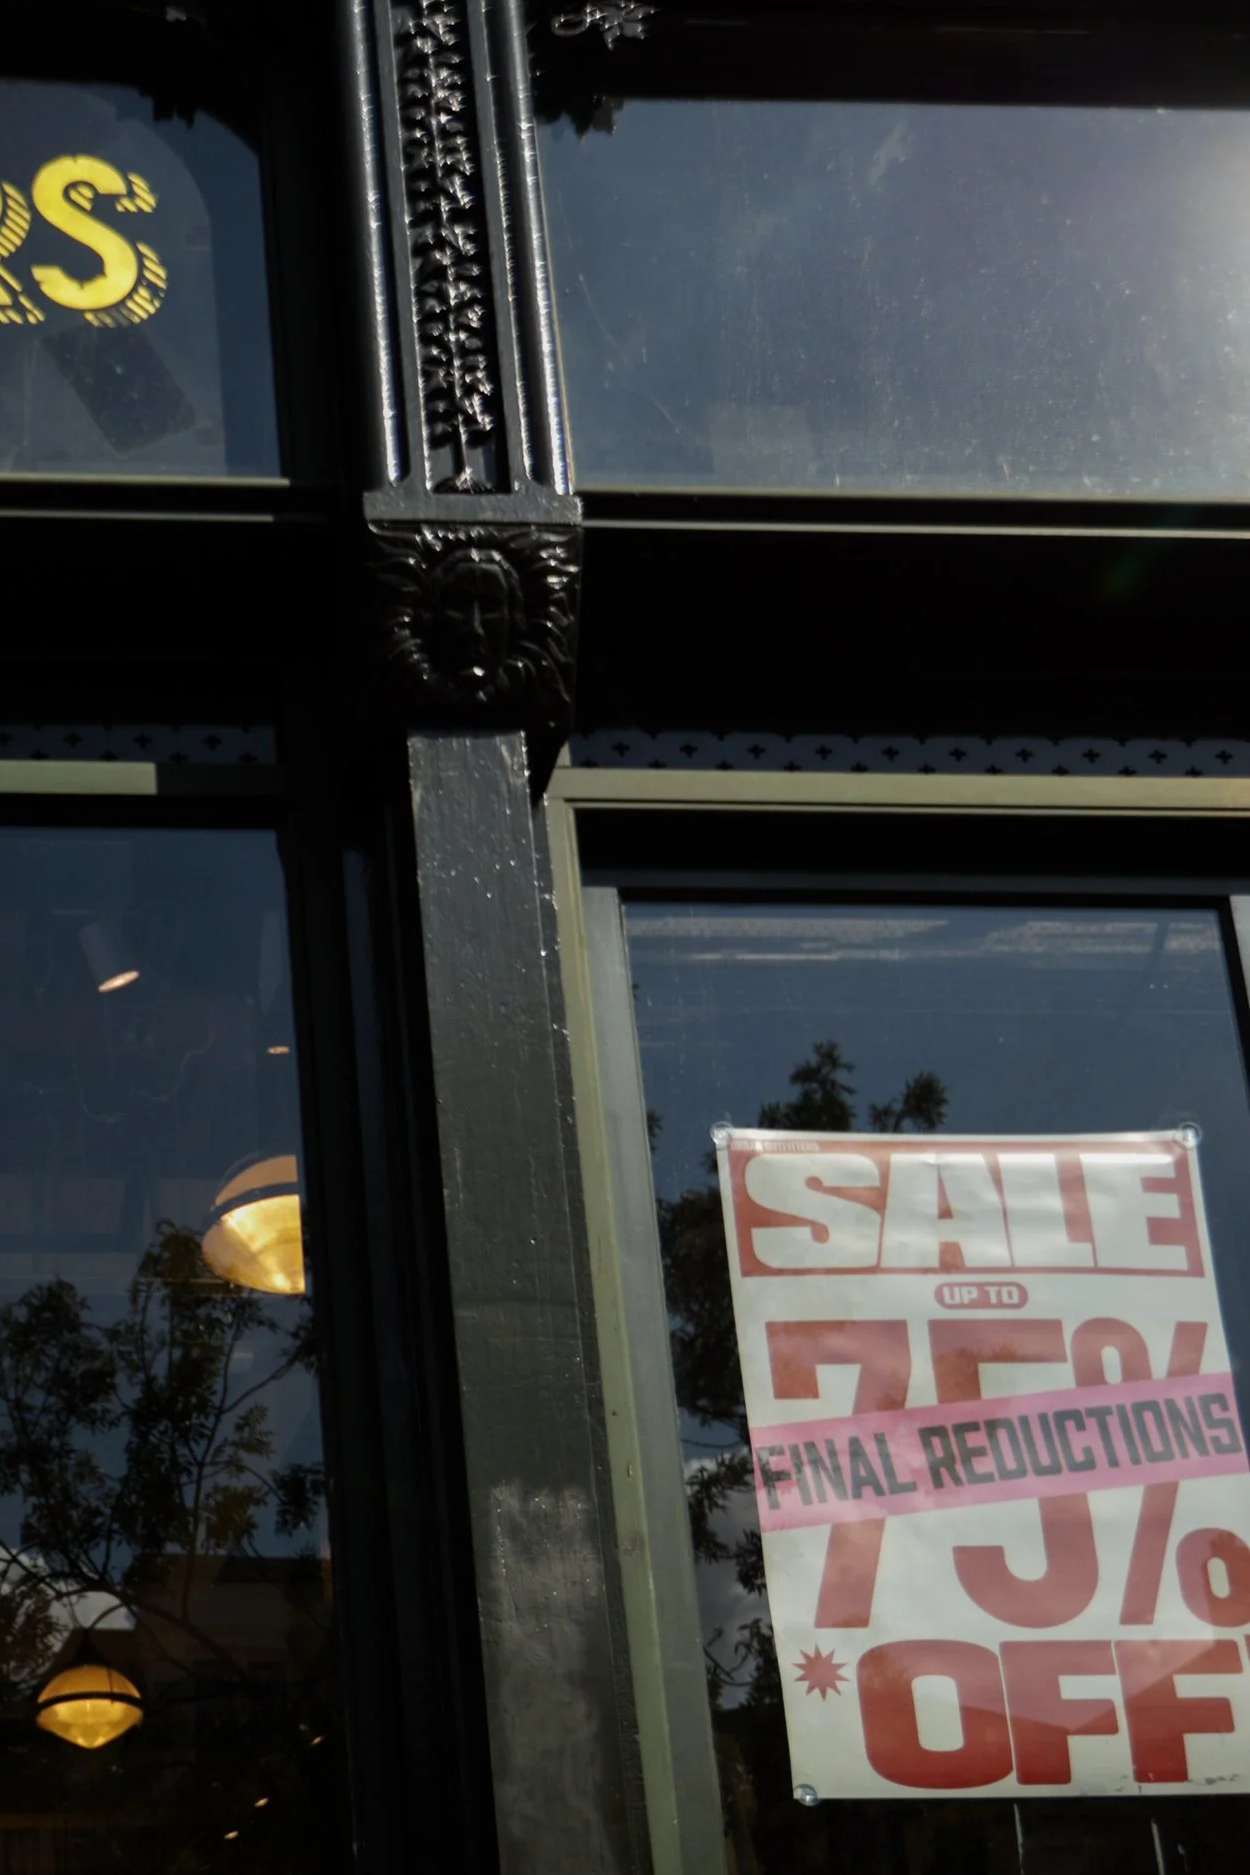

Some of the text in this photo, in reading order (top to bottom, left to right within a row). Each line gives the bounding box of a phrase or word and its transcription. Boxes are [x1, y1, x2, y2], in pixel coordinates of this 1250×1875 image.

[745, 1152, 1188, 1271] SALE
[942, 1285, 1020, 1304] UP TO
[755, 1392, 1243, 1510] FINAL REDUCTIONS
[765, 1317, 1250, 1629] 75%
[856, 1638, 1243, 1789] OFF
